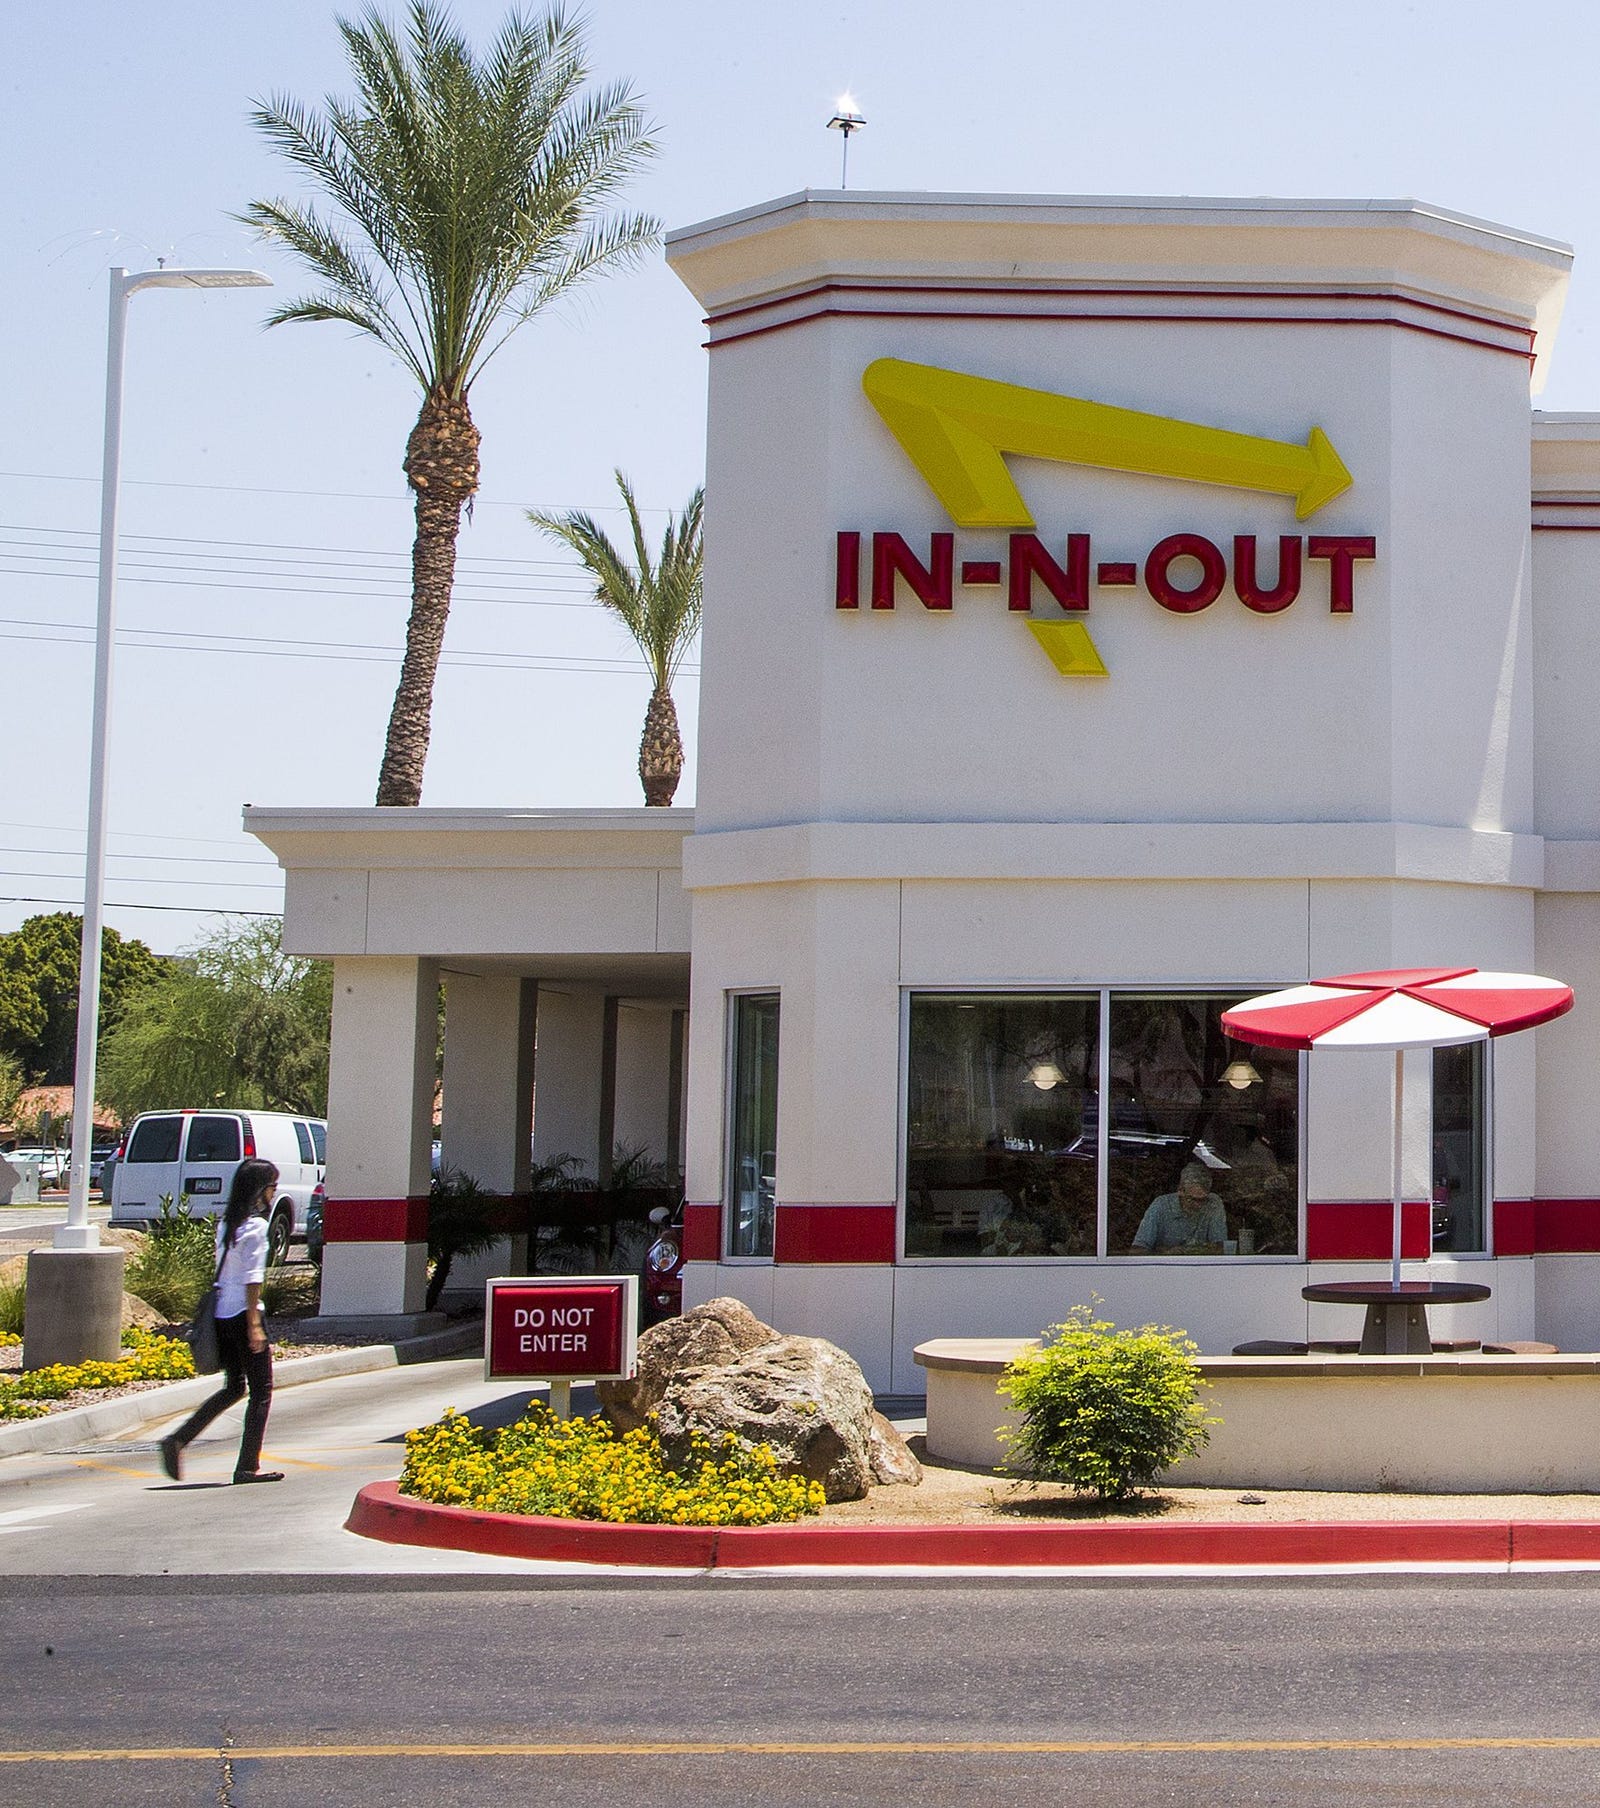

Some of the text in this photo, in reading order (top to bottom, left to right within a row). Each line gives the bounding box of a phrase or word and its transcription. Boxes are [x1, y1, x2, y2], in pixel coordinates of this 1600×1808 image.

[835, 531, 1377, 615] IN-N-OUT
[514, 1308, 594, 1328] DO NOT
[520, 1334, 588, 1353] ENTER
